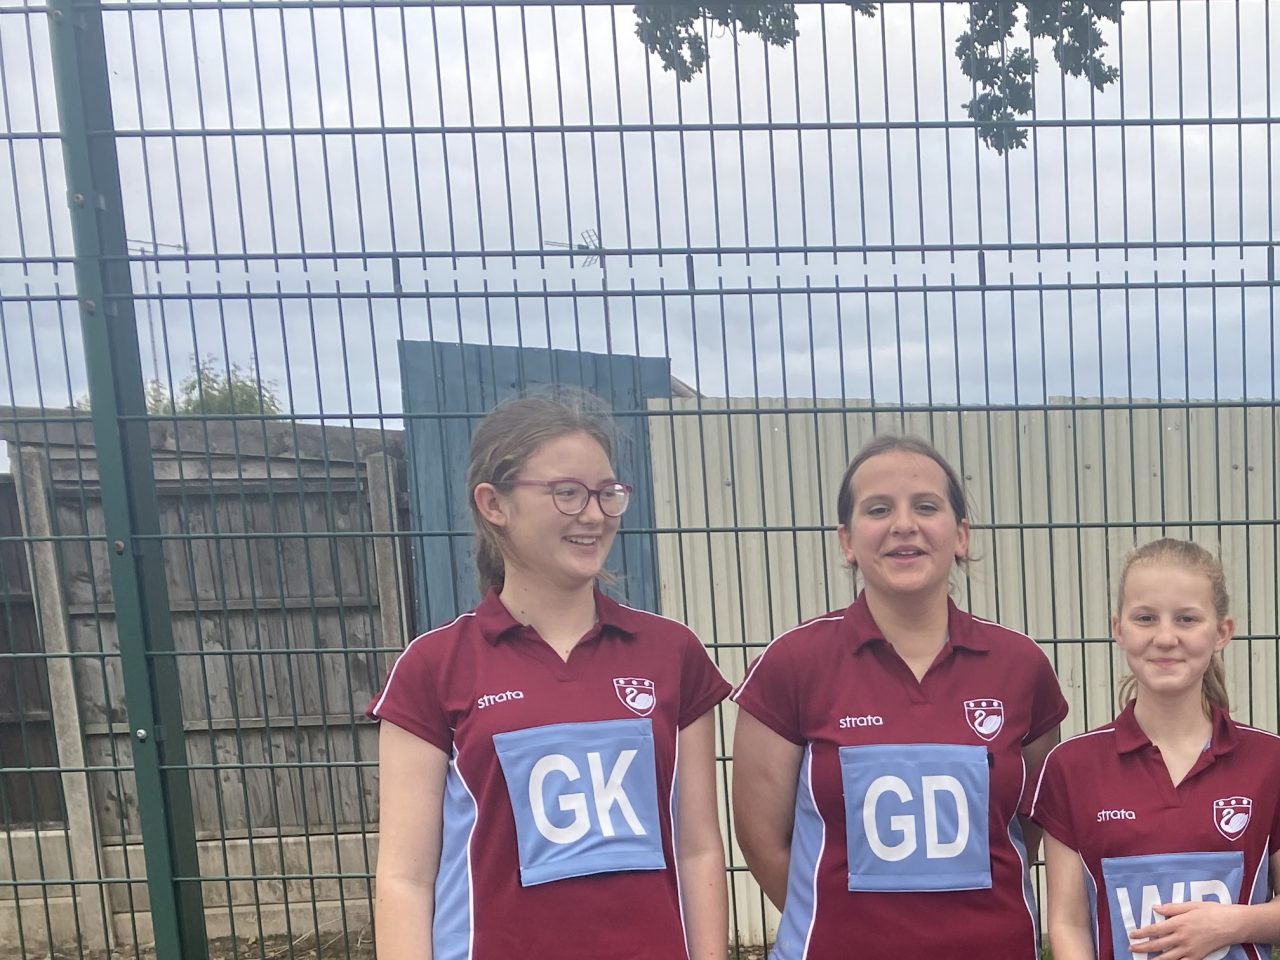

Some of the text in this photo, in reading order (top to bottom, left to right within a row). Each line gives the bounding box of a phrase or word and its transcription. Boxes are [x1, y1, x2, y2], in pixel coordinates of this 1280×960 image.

[477, 690, 524, 709] strata
[839, 714, 884, 729] strata
[529, 749, 646, 845] GK
[863, 775, 970, 862] GD
[1097, 808, 1136, 823] strata
